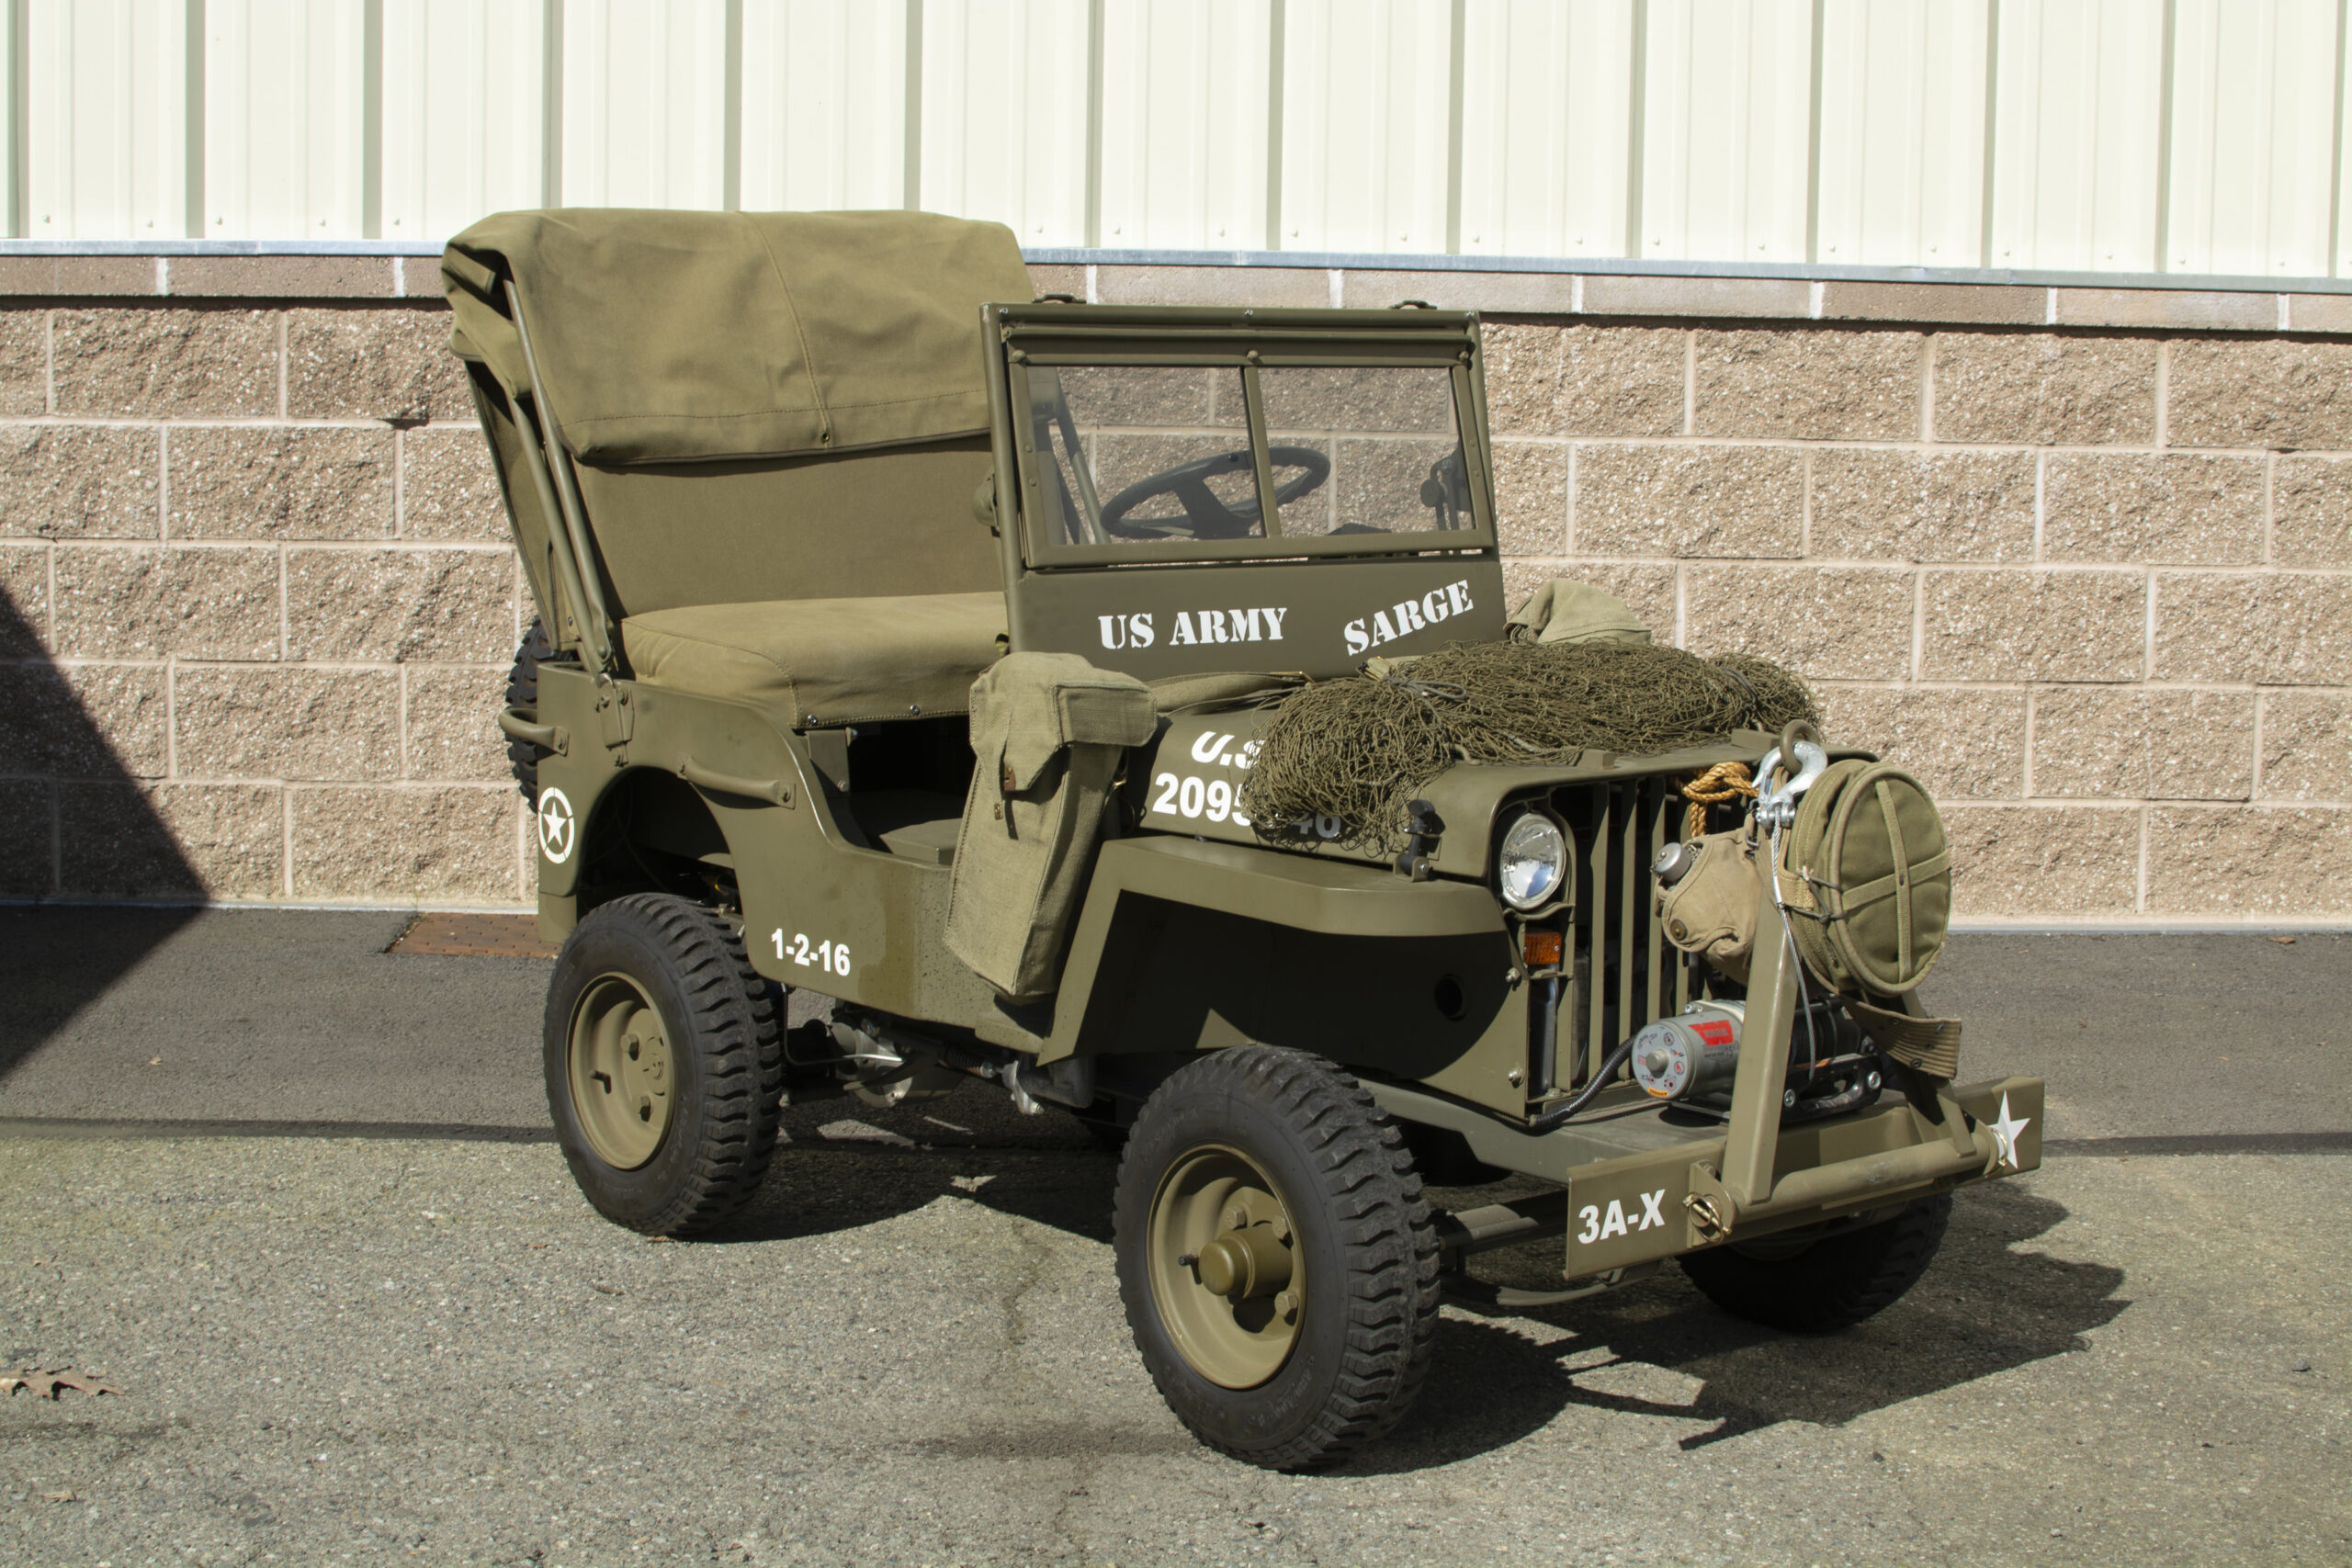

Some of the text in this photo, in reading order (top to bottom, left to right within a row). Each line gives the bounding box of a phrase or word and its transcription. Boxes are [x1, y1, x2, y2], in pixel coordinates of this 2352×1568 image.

[1098, 607, 1287, 649] US ARMY
[1343, 579, 1475, 657] SARGE
[771, 928, 851, 976] 1-2-16
[1577, 1189, 1667, 1245] 3A-X
